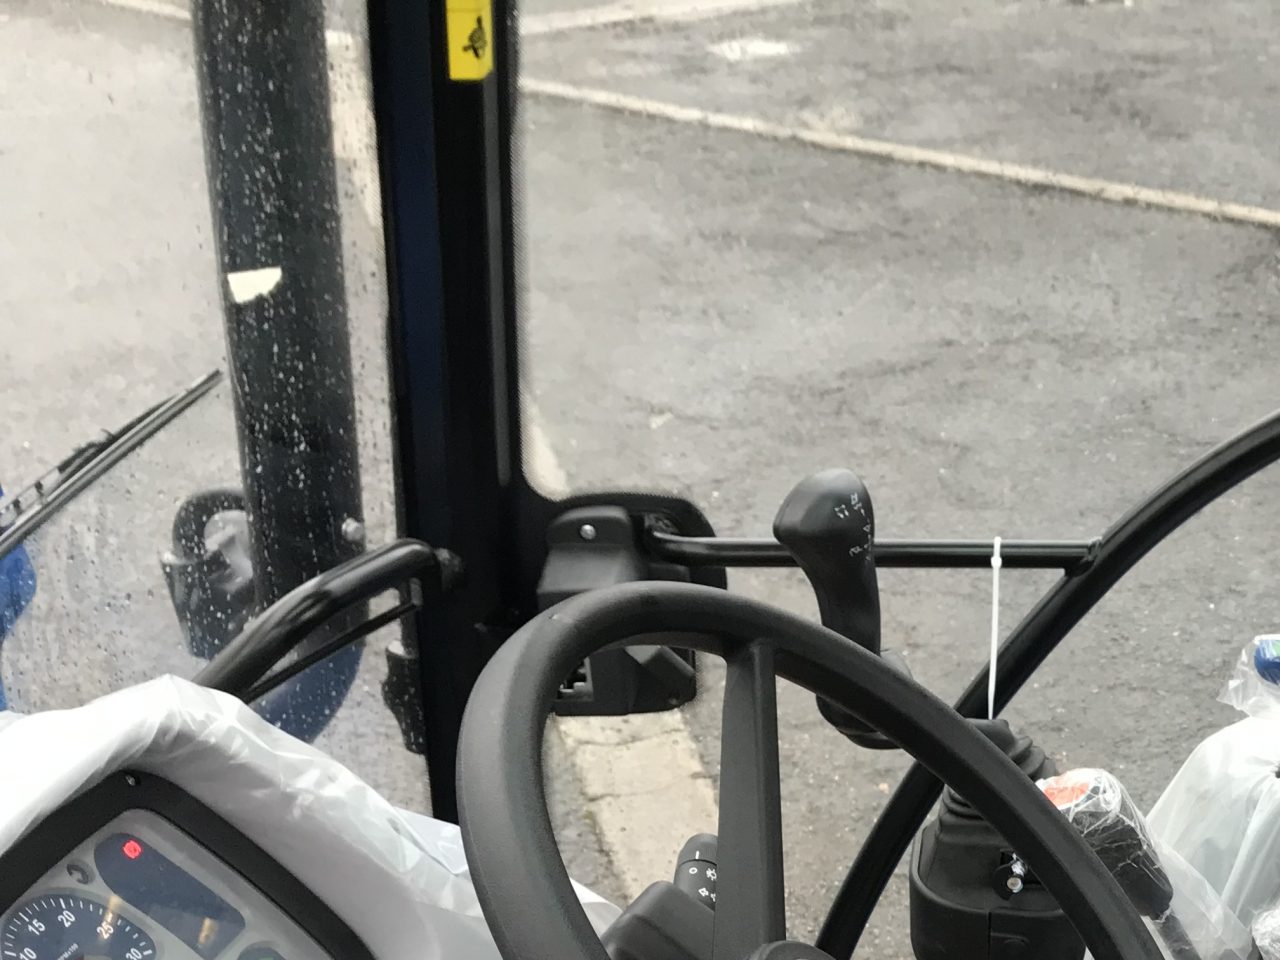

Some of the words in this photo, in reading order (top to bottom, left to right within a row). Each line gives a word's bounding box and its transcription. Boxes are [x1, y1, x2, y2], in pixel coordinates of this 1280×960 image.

[28, 918, 46, 936] 15
[57, 909, 76, 928] 20
[96, 920, 114, 940] 25
